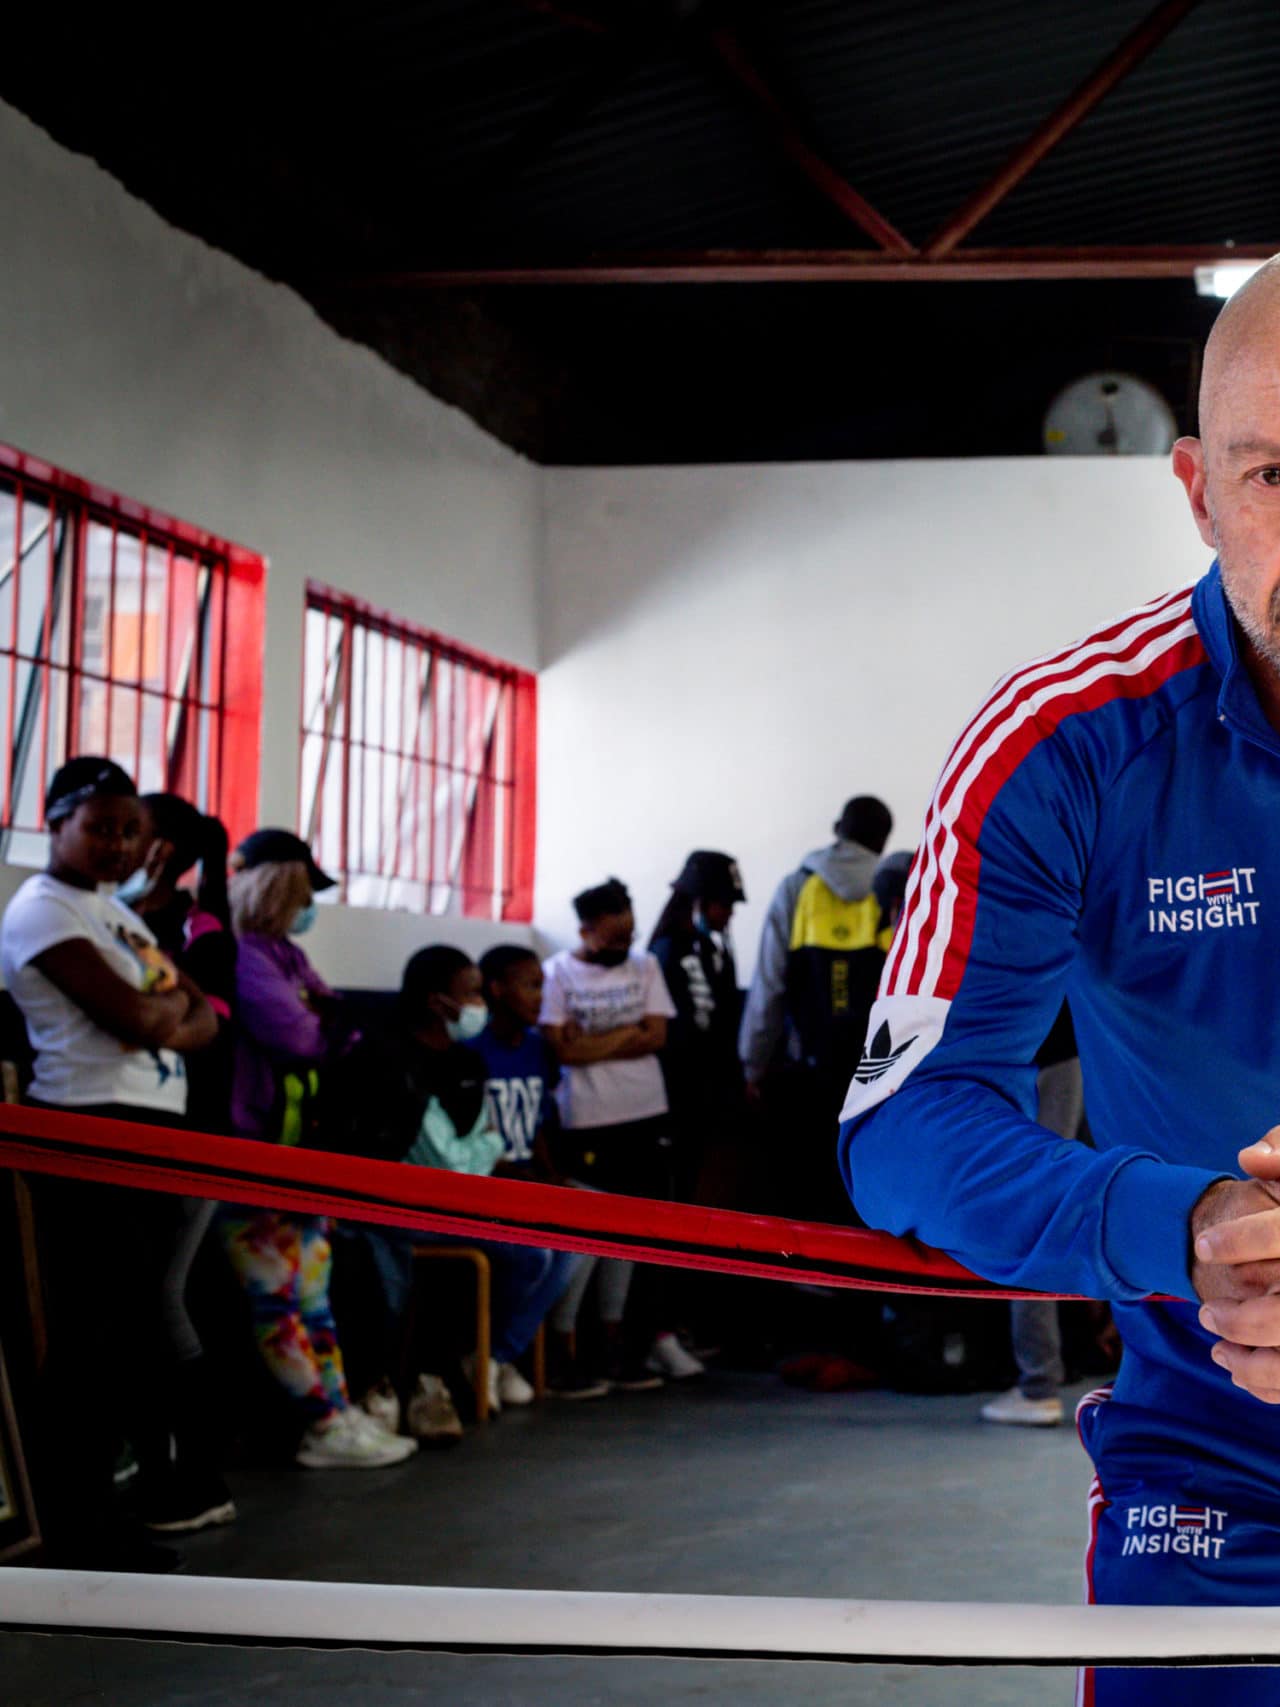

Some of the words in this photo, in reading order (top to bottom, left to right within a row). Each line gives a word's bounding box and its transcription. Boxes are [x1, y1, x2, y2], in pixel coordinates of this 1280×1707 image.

[1148, 867, 1256, 904] FIGHT
[1206, 893, 1233, 906] WITH
[1149, 902, 1260, 933] INSIGHT
[1127, 1504, 1228, 1531] FIGHT
[1122, 1533, 1226, 1559] INSIGHT
